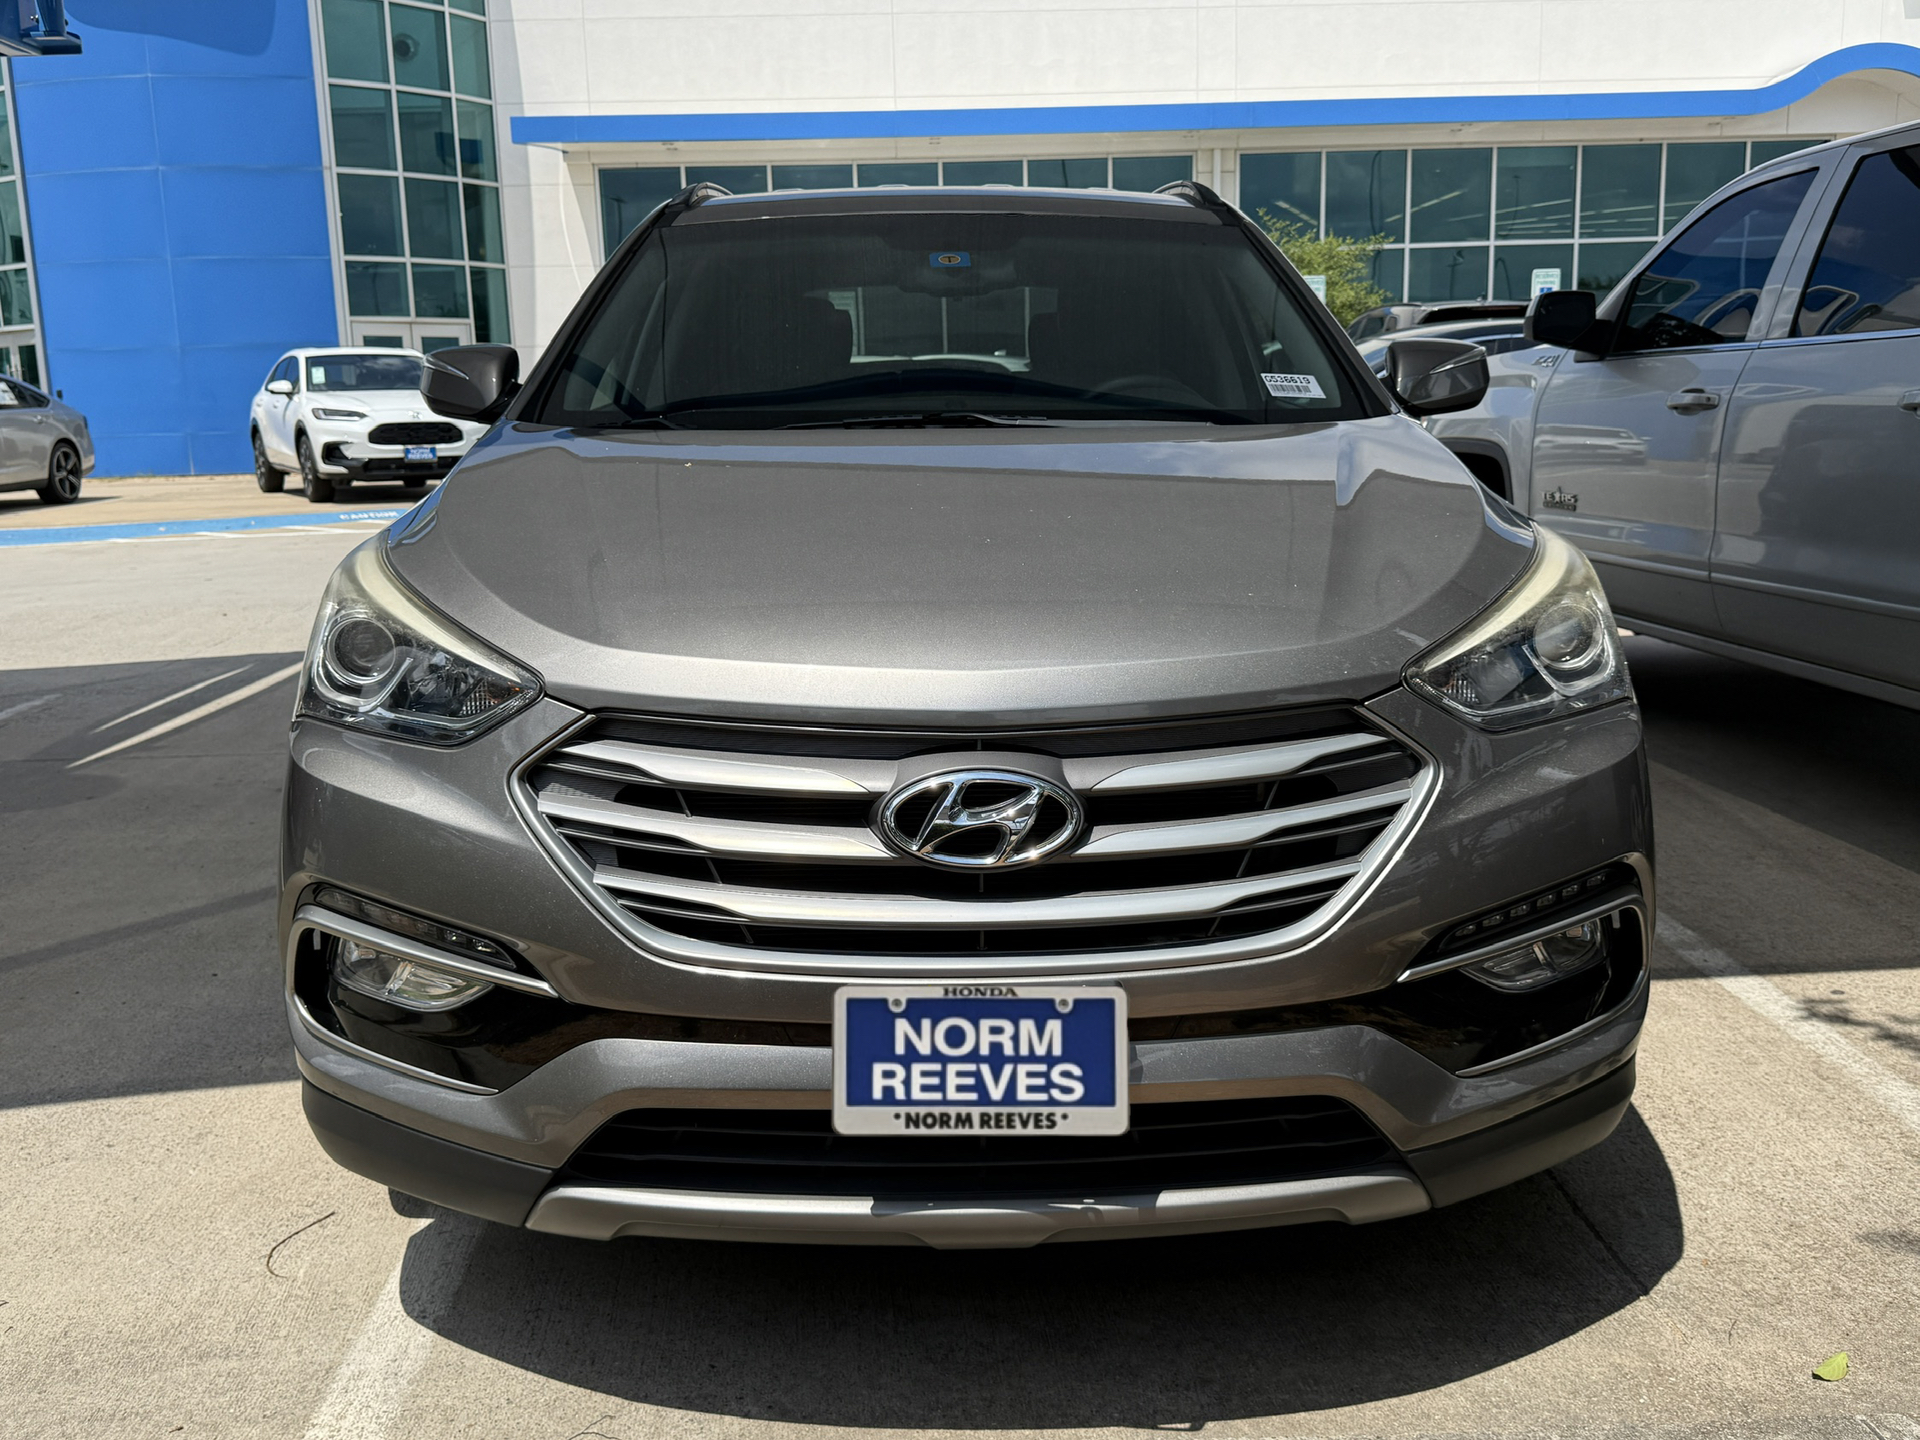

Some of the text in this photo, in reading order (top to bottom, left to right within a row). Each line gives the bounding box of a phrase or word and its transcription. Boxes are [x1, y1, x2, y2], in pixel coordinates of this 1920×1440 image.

[943, 987, 1018, 997] HONDA
[894, 1017, 1063, 1057] NORM
[872, 1062, 1085, 1101] REEVES
[904, 1112, 1057, 1129] NORM REEVES
